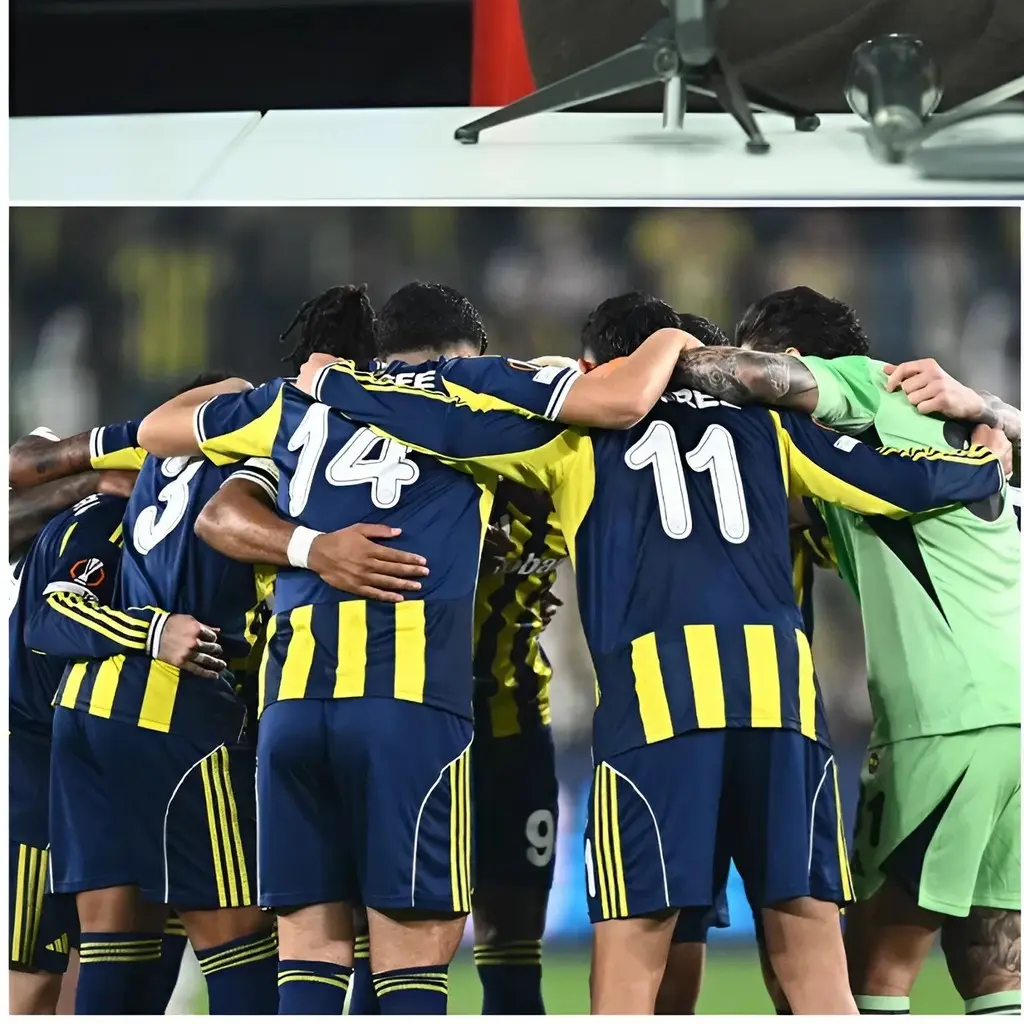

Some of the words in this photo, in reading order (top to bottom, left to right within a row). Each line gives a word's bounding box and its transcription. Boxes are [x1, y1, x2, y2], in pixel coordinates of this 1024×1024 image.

[131, 454, 203, 556] 3
[286, 402, 420, 518] 14
[624, 419, 750, 545] 11
[525, 809, 555, 867] 9
